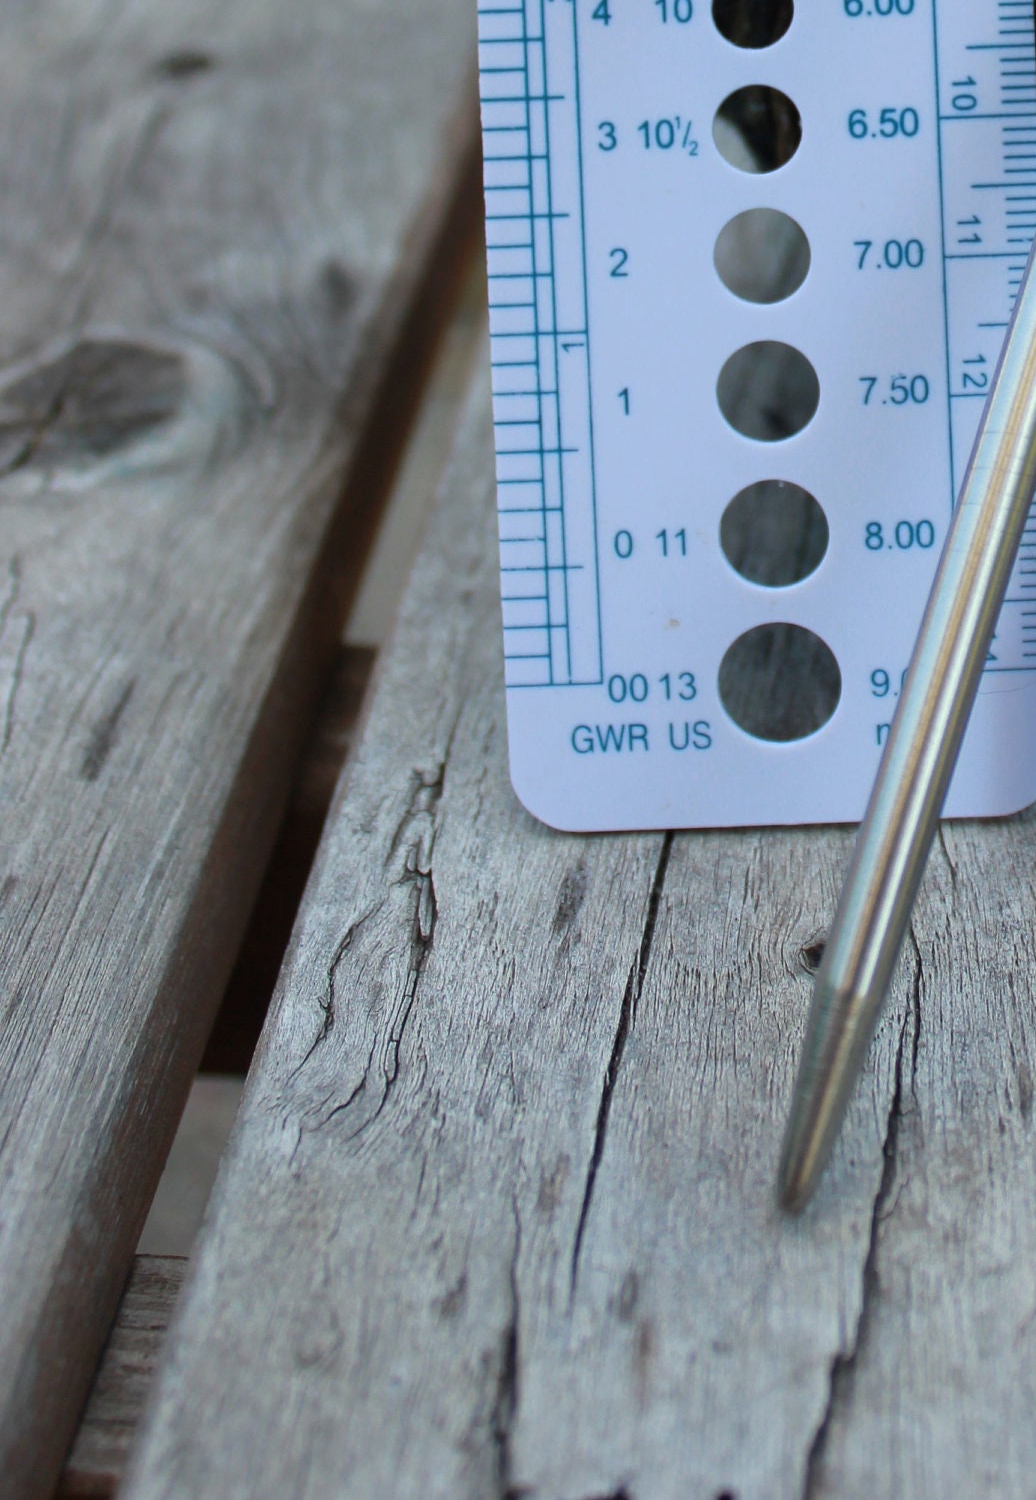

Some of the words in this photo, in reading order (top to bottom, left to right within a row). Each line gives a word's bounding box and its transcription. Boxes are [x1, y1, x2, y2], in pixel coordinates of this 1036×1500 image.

[952, 75, 977, 112] 10
[598, 121, 617, 151] 3
[848, 107, 919, 139] 6.50
[957, 215, 982, 245] 11
[610, 248, 628, 278] 2
[854, 239, 925, 269] 7.00
[561, 342, 585, 353] 1
[962, 353, 987, 389] 12
[618, 388, 629, 415] 1
[859, 374, 929, 405] 7.50
[614, 530, 633, 559] 0
[656, 528, 686, 556] 11
[865, 520, 935, 550] 8.00
[608, 674, 648, 703] 00
[659, 672, 697, 701] 13
[870, 668, 910, 697] 9.
[571, 724, 648, 754] GWR
[669, 721, 712, 751] US
